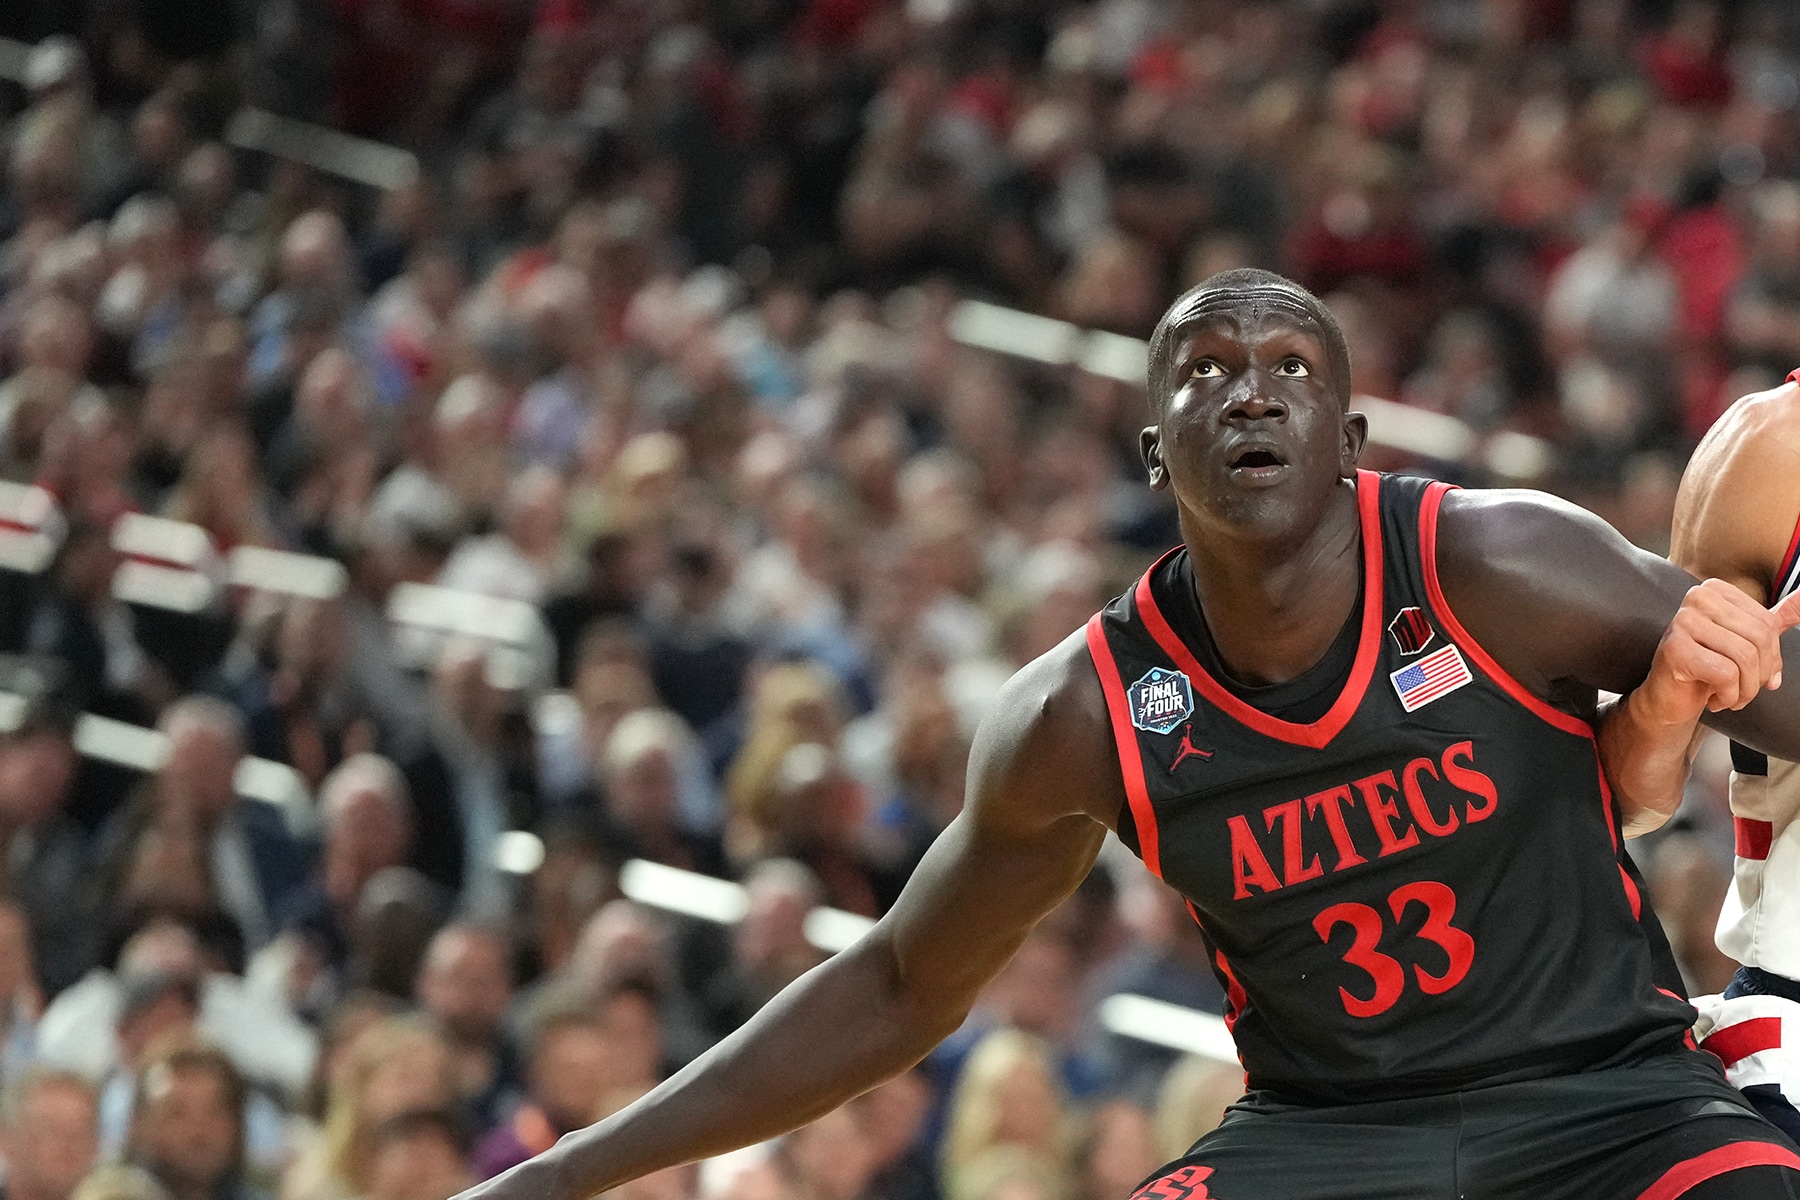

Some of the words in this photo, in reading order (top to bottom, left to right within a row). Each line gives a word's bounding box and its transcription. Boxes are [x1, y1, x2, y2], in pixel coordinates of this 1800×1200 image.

[1141, 681, 1180, 703] FINAL
[1147, 695, 1183, 717] FOUR
[1226, 740, 1498, 900] AZTECS
[1312, 881, 1475, 1019] 33
